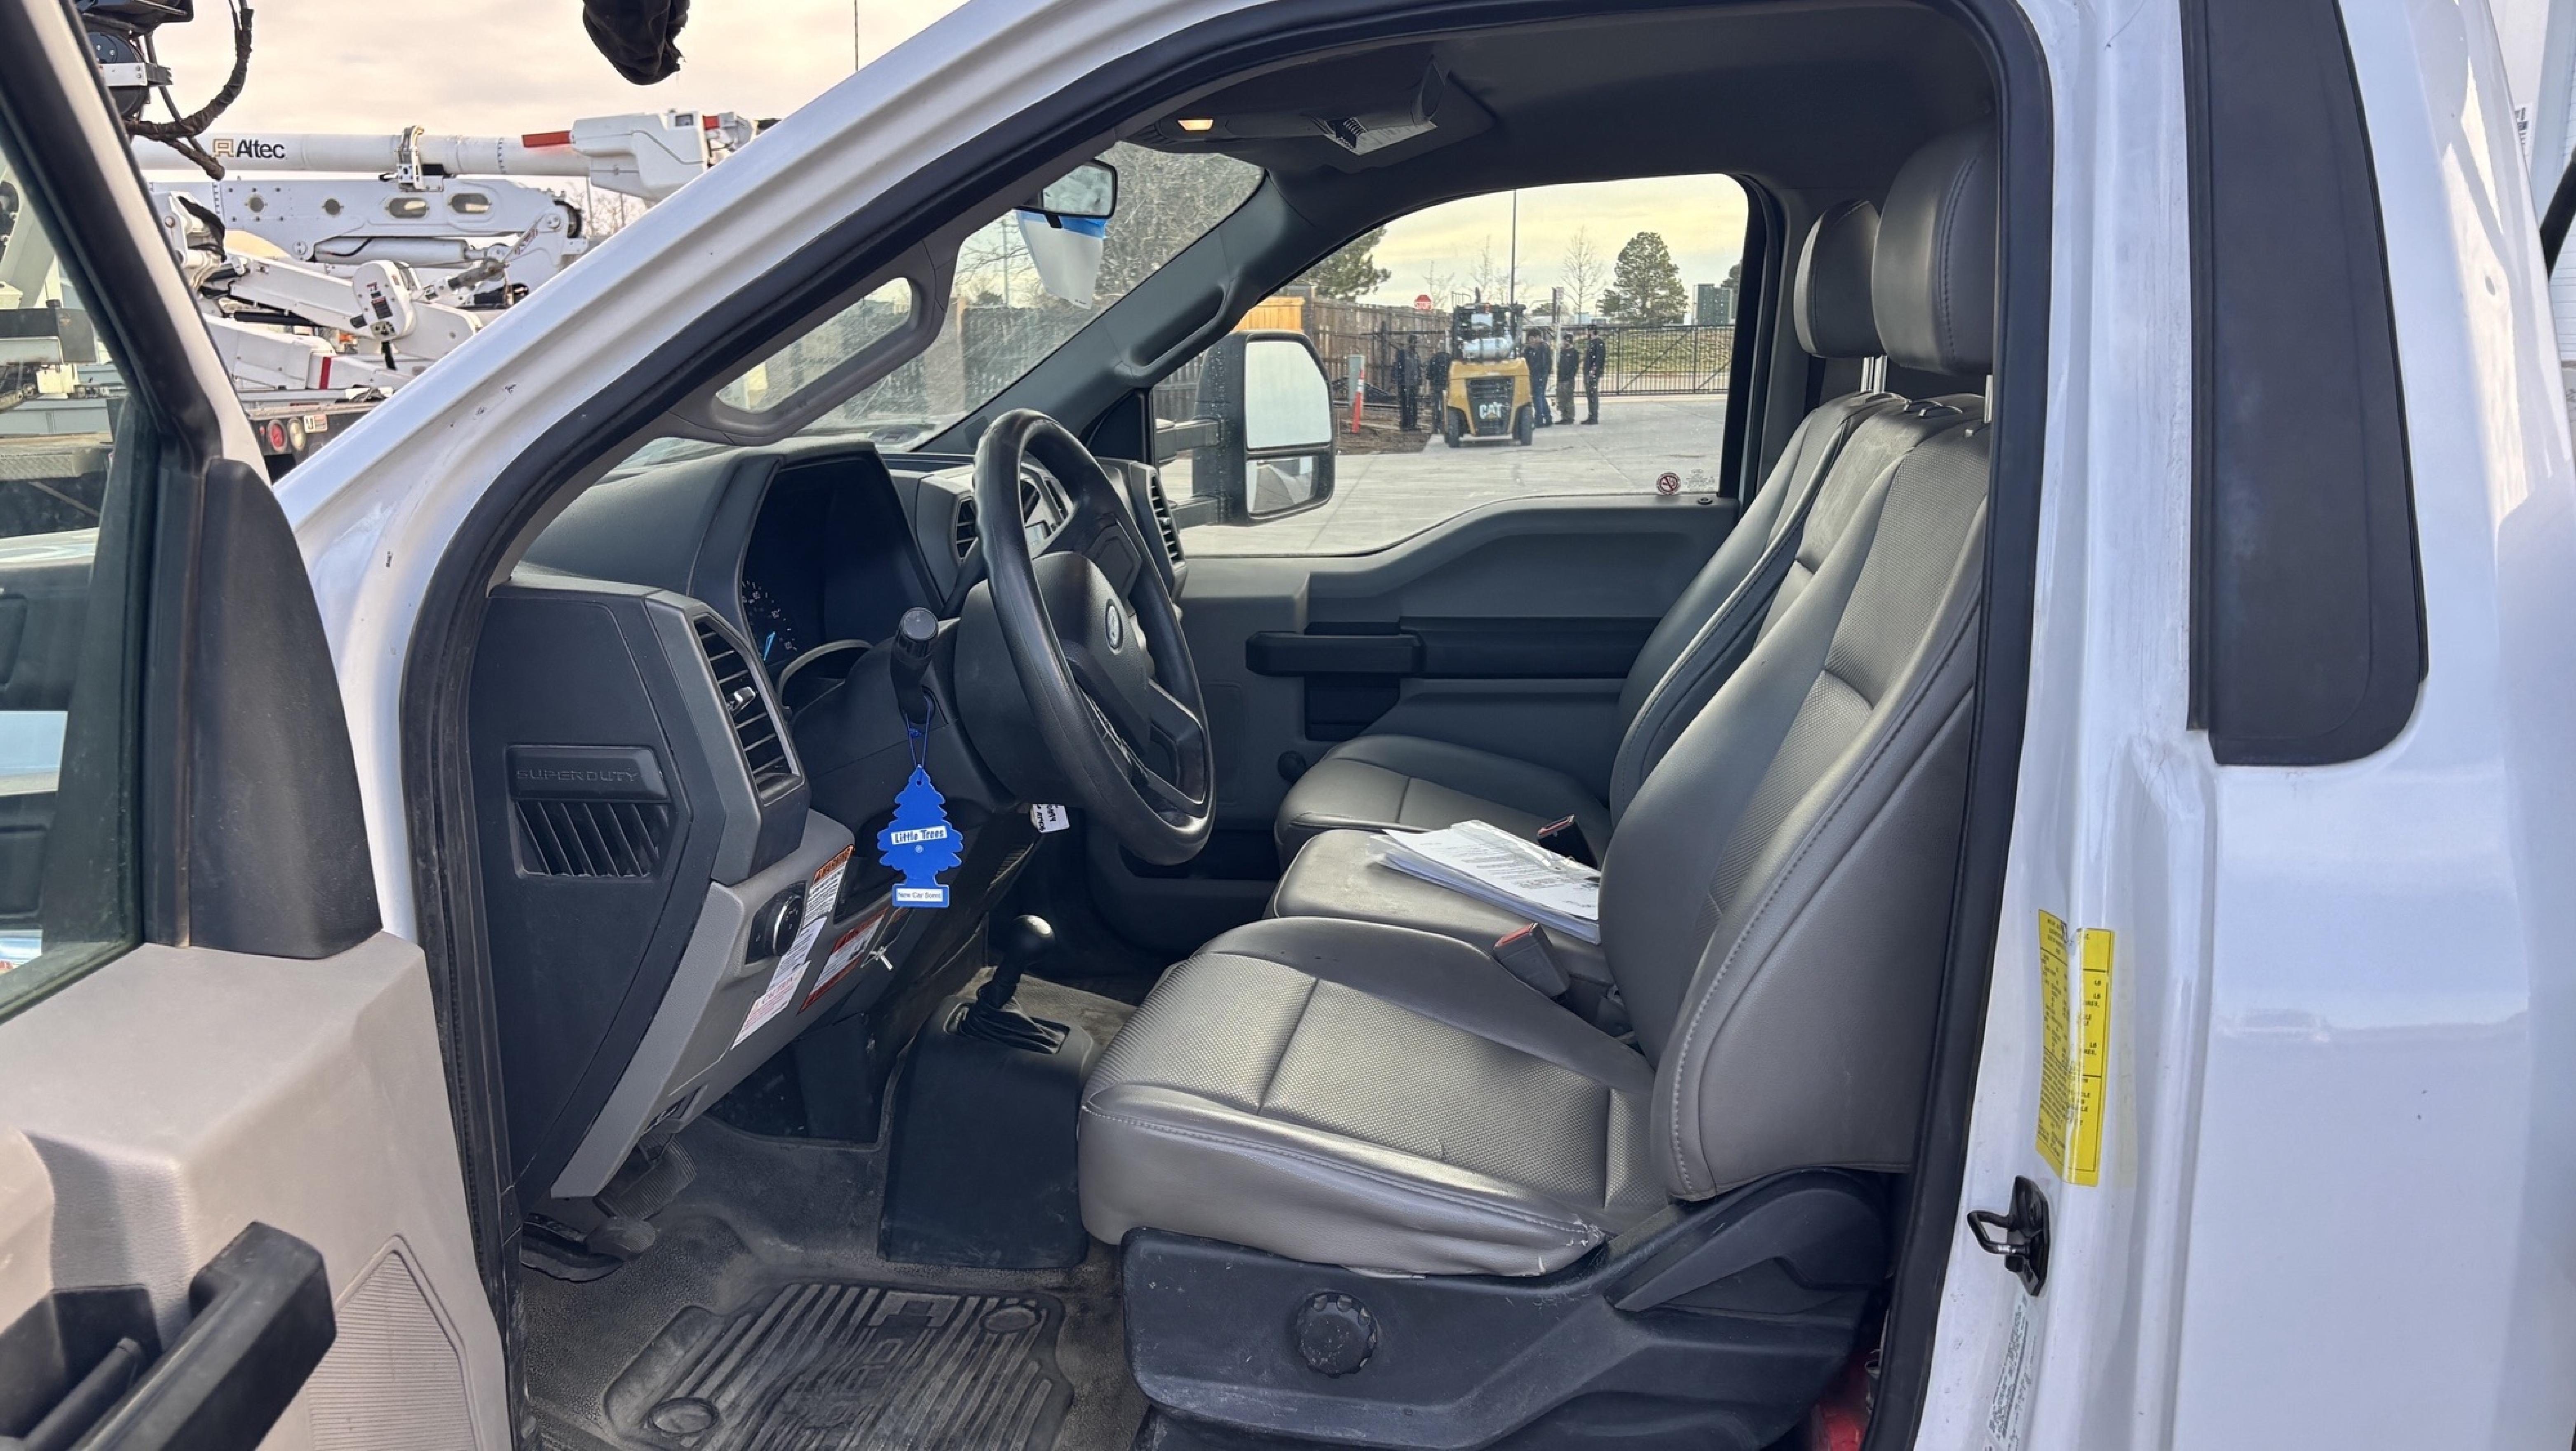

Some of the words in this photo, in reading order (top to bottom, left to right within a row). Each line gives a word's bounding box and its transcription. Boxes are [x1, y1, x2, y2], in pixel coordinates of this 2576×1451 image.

[235, 139, 285, 159] Altec
[1480, 401, 1503, 419] CAT
[516, 769, 584, 781] SUPER
[587, 771, 638, 782] DUTY
[895, 831, 918, 843] Little
[920, 830, 945, 839] Trees
